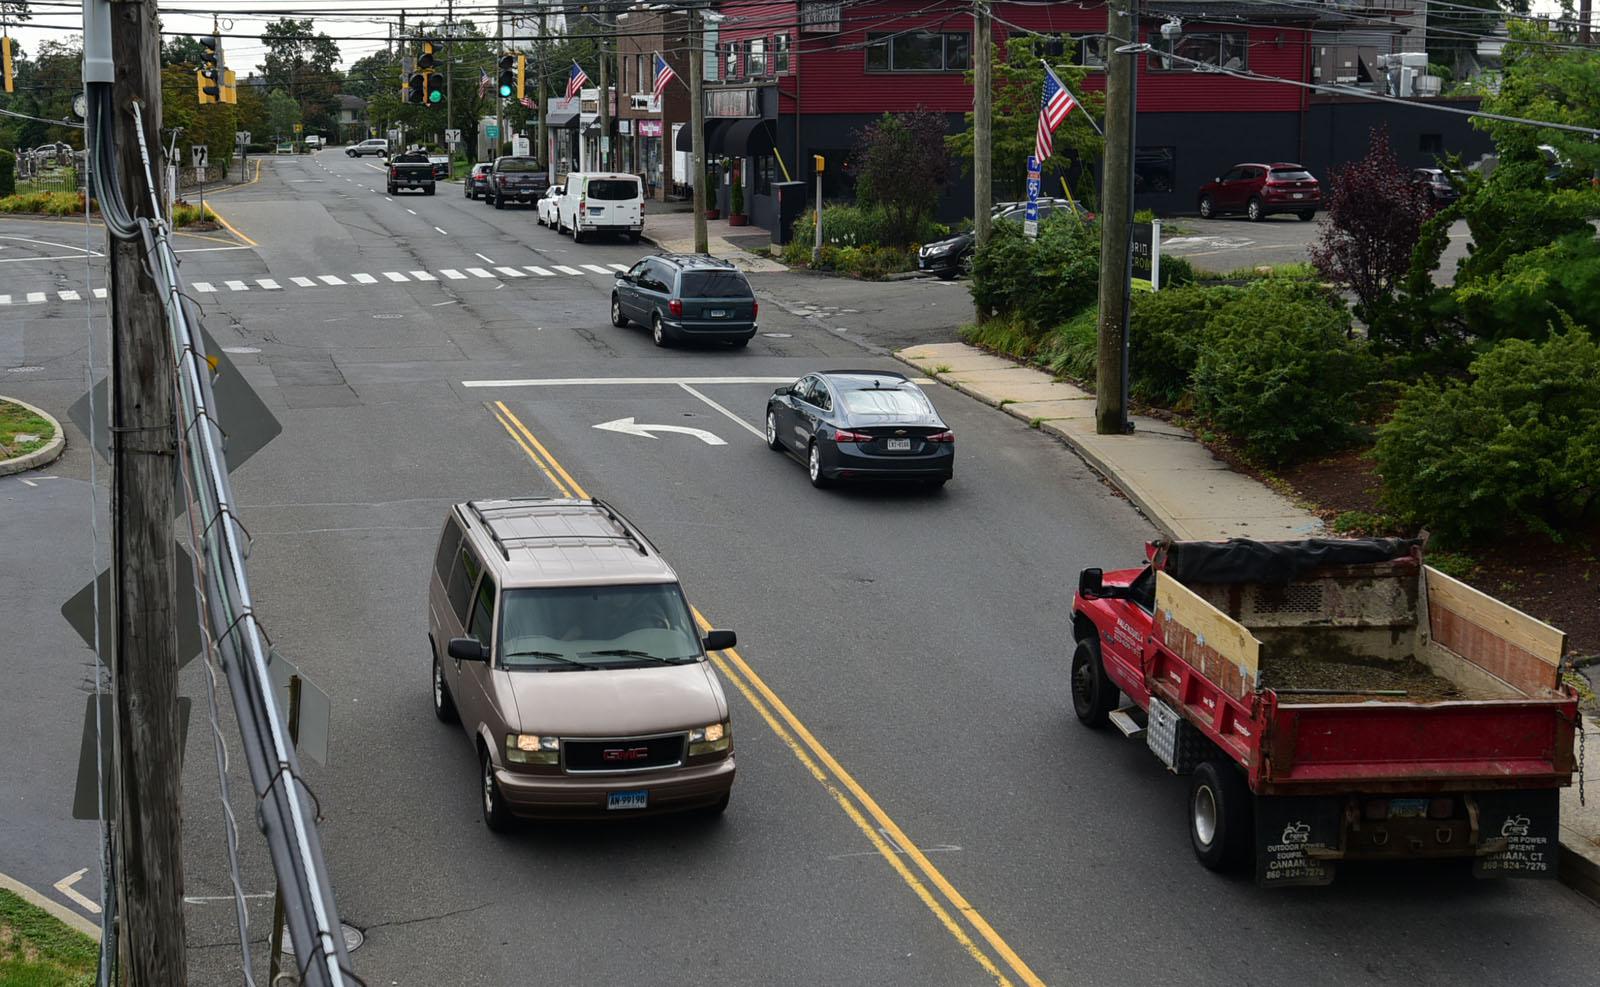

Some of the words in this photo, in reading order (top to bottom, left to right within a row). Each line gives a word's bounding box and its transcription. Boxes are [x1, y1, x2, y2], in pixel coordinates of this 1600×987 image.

[1028, 182, 1038, 197] 95
[603, 747, 648, 760] GMC
[1267, 844, 1299, 852] OUTDOOR
[1530, 853, 1543, 861] CT
